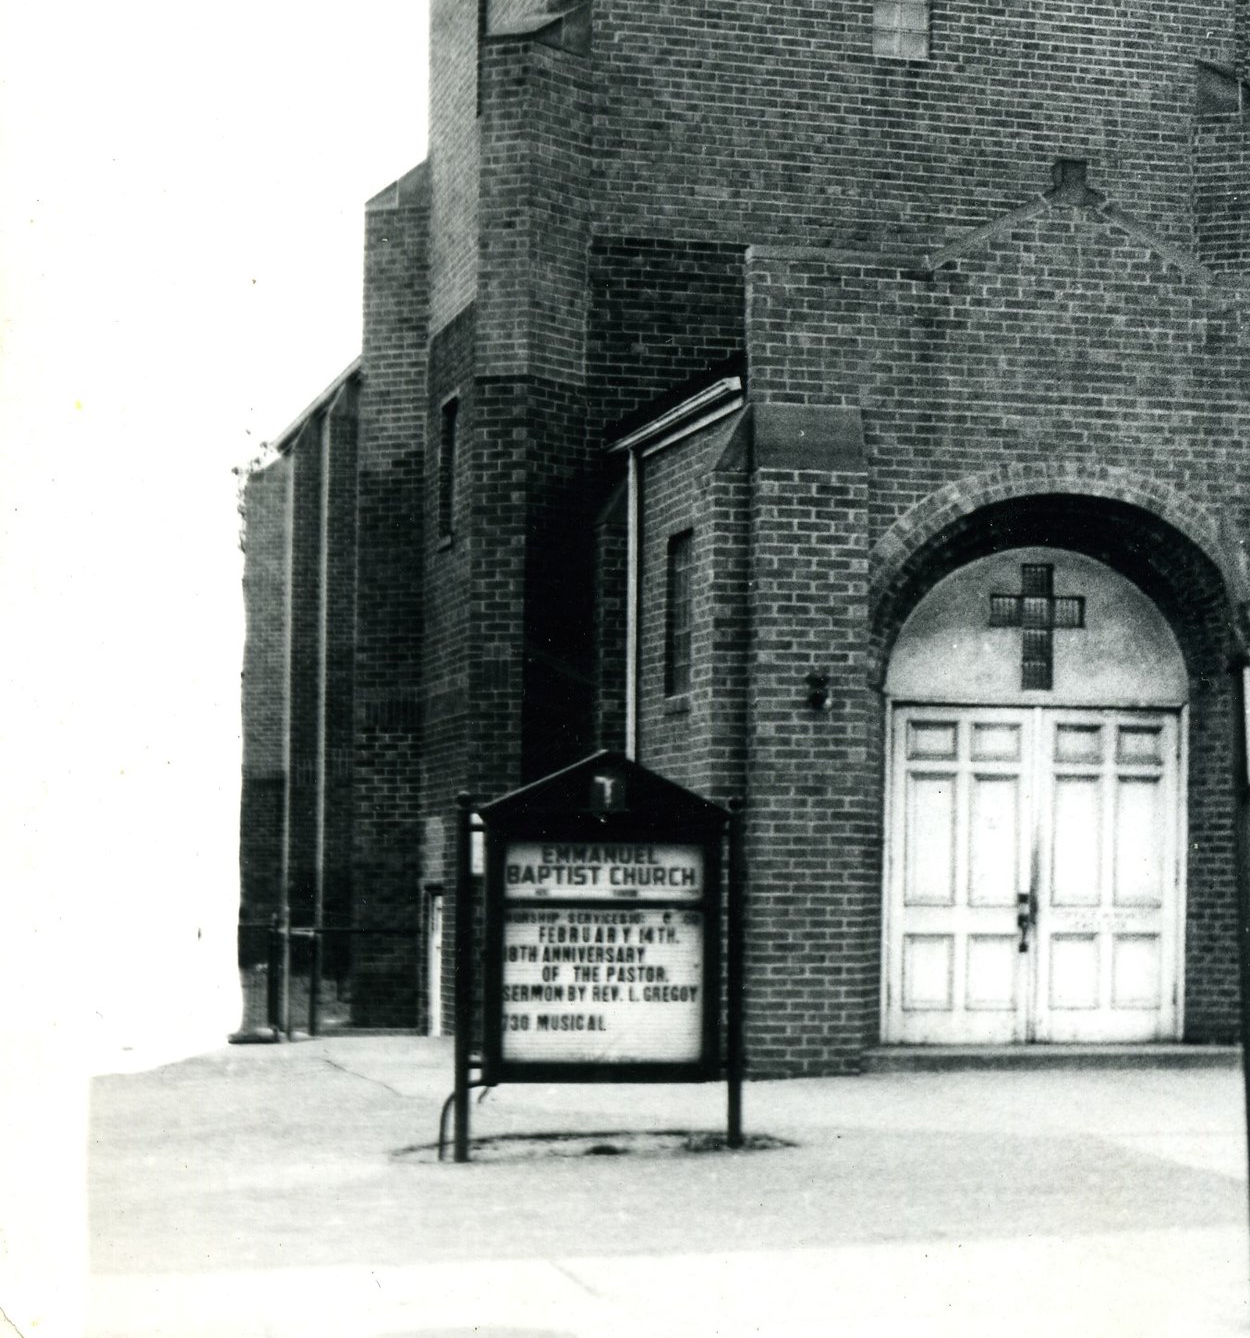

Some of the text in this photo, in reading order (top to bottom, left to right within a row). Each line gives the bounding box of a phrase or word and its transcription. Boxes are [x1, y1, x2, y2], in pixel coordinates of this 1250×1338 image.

[541, 844, 660, 865] EMMANUEL
[506, 865, 696, 886] BAPTIST CHURCH
[539, 926, 630, 944] FEBRUARY
[542, 945, 645, 963] ANNIVERSARY
[542, 965, 669, 983] OF THE PASTOR.
[502, 985, 563, 1002] SERMON
[567, 985, 587, 1002] BY
[592, 985, 624, 1002] REV.
